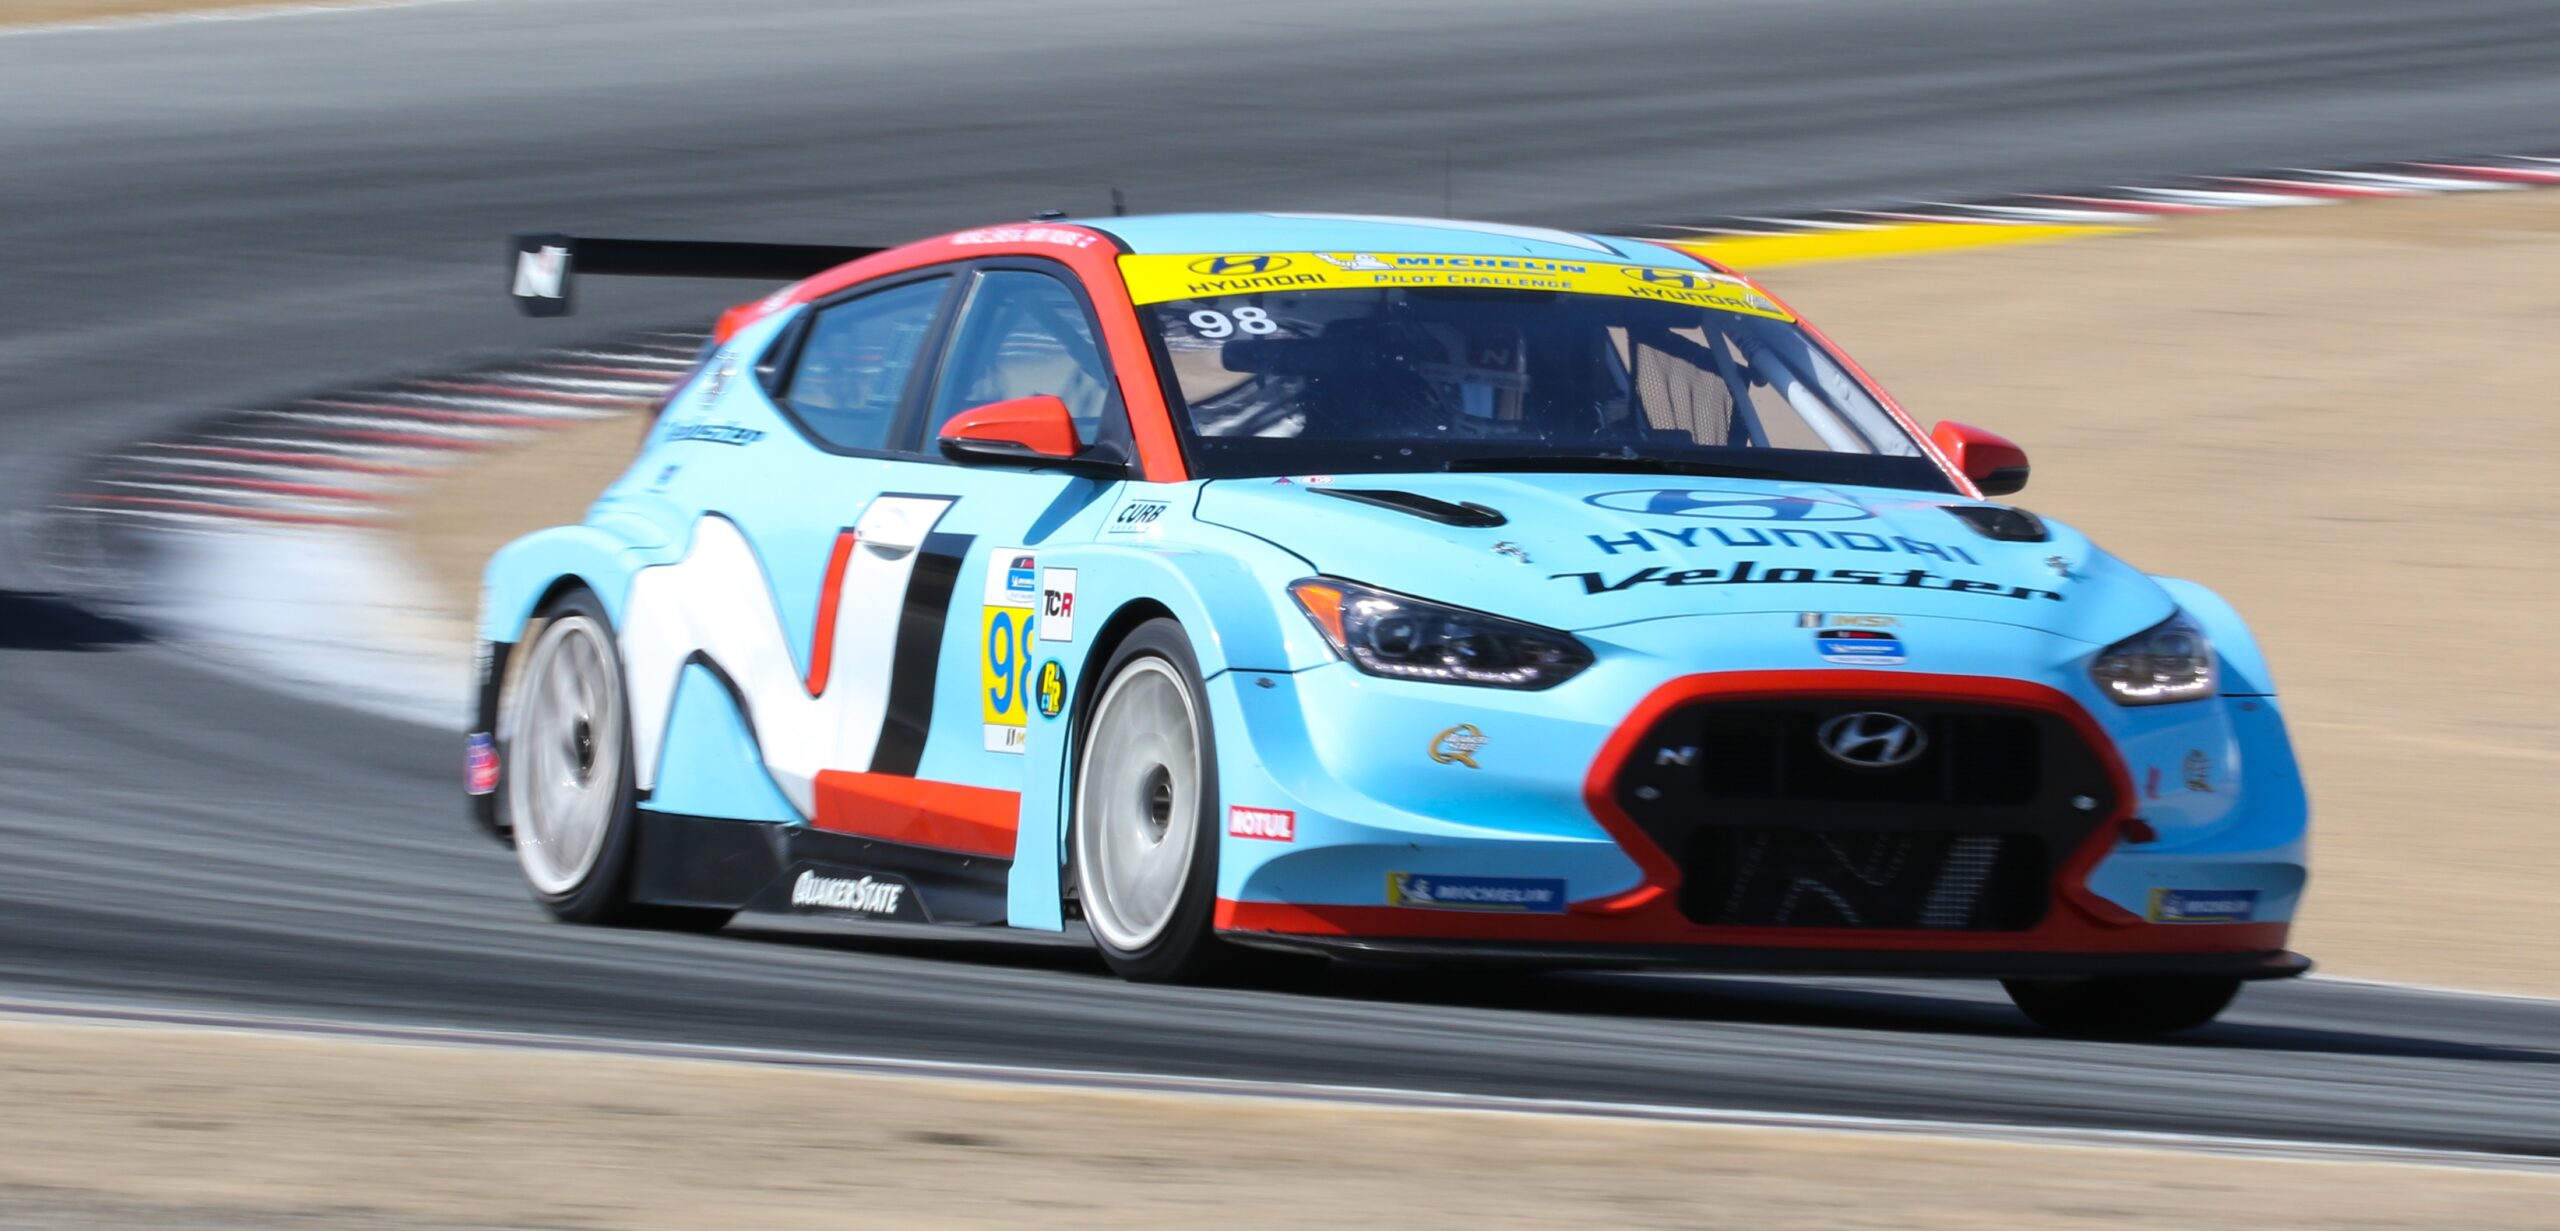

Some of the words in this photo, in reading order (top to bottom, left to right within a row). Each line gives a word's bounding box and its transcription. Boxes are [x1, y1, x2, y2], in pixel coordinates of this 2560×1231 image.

[1396, 256, 1587, 273] MICHELIN
[1187, 272, 1327, 293] HYUNDAI
[1627, 285, 1755, 310] HYUNDAI
[1188, 305, 1278, 339] 98
[1116, 503, 1168, 524] CURB
[1585, 526, 1980, 566] HYUNDAI
[1547, 560, 2065, 602] Veloster
[1044, 589, 1074, 618] TCR
[1229, 808, 1293, 838] MOTUL
[1435, 885, 1554, 903] MICHELIN
